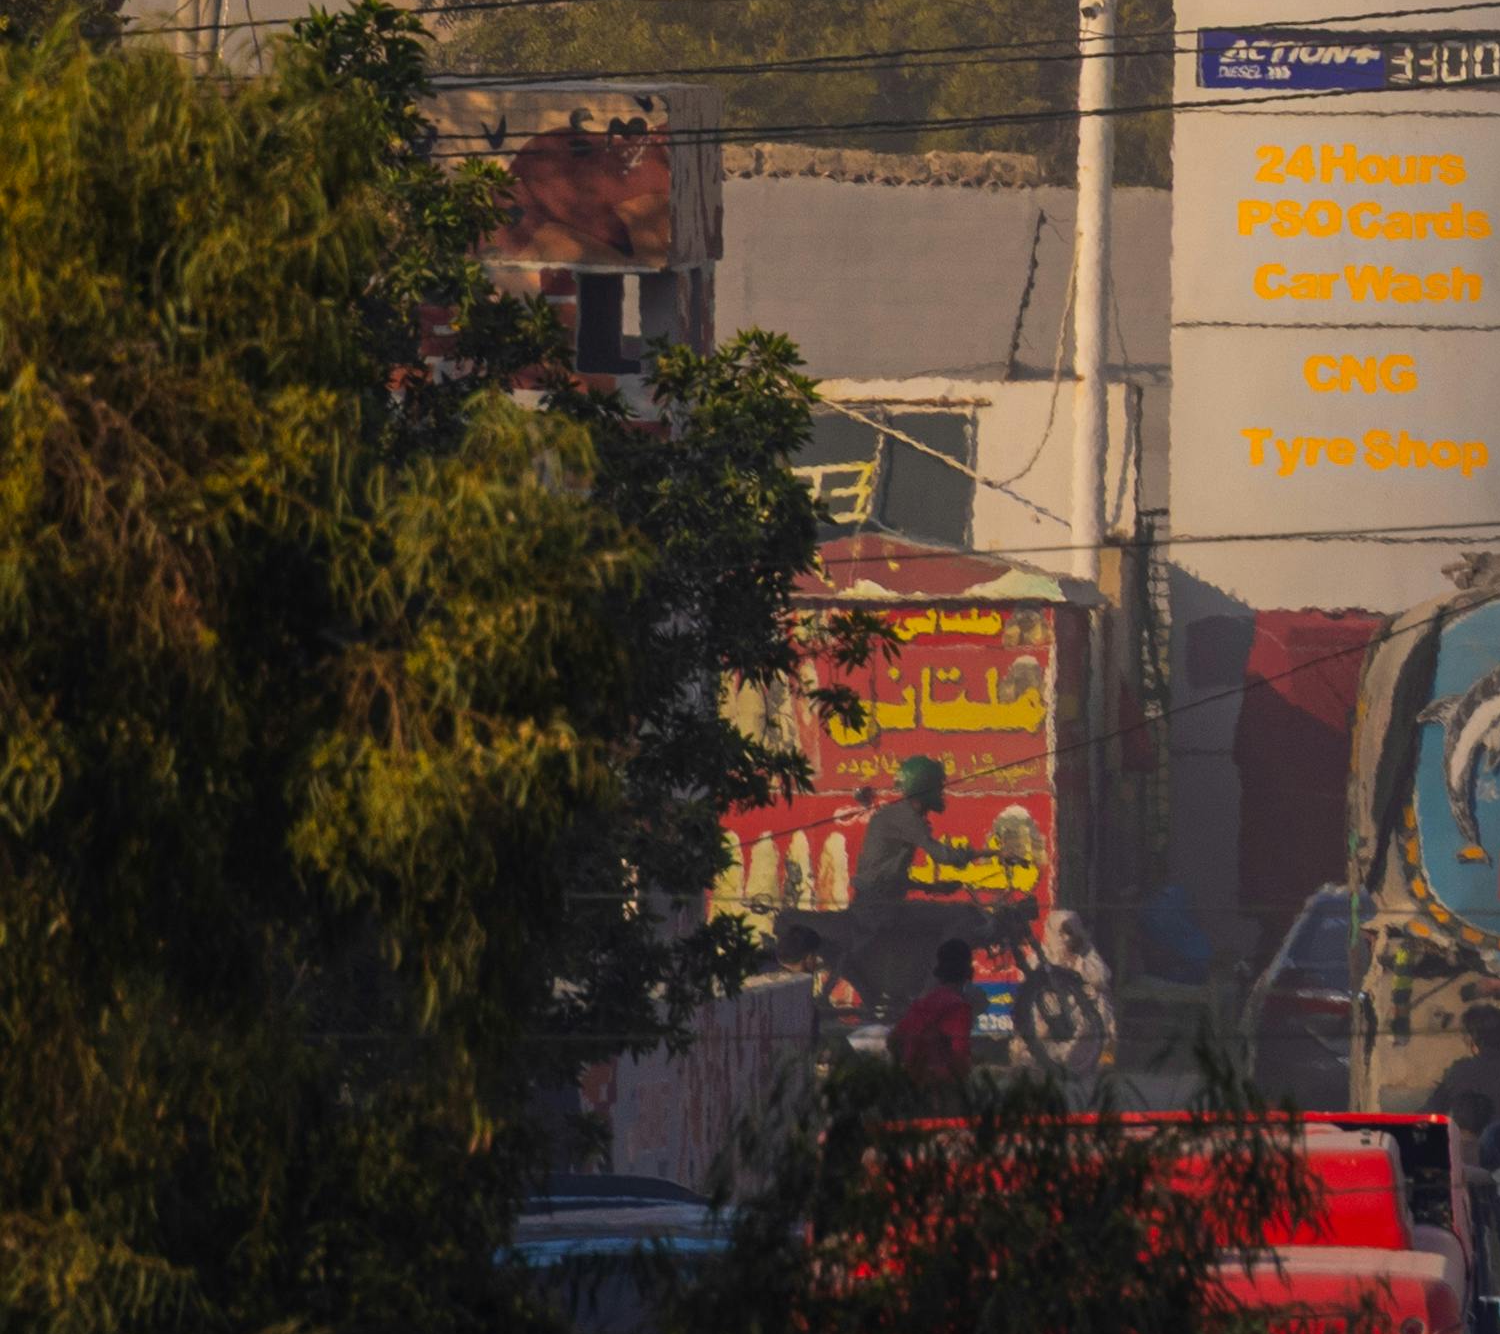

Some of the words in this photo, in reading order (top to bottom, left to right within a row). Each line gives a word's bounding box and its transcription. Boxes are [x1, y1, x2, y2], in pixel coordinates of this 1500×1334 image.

[1217, 66, 1263, 80] DIESEL
[1255, 144, 1316, 185] 24
[1321, 144, 1468, 187] Hours
[1238, 200, 1343, 239] PSO
[1347, 202, 1493, 241] Cards
[1253, 263, 1341, 301] Car
[1343, 263, 1484, 303] Wash
[1303, 353, 1420, 395] CNG
[1239, 427, 1357, 478] Tyre
[1363, 428, 1490, 480] Shop
